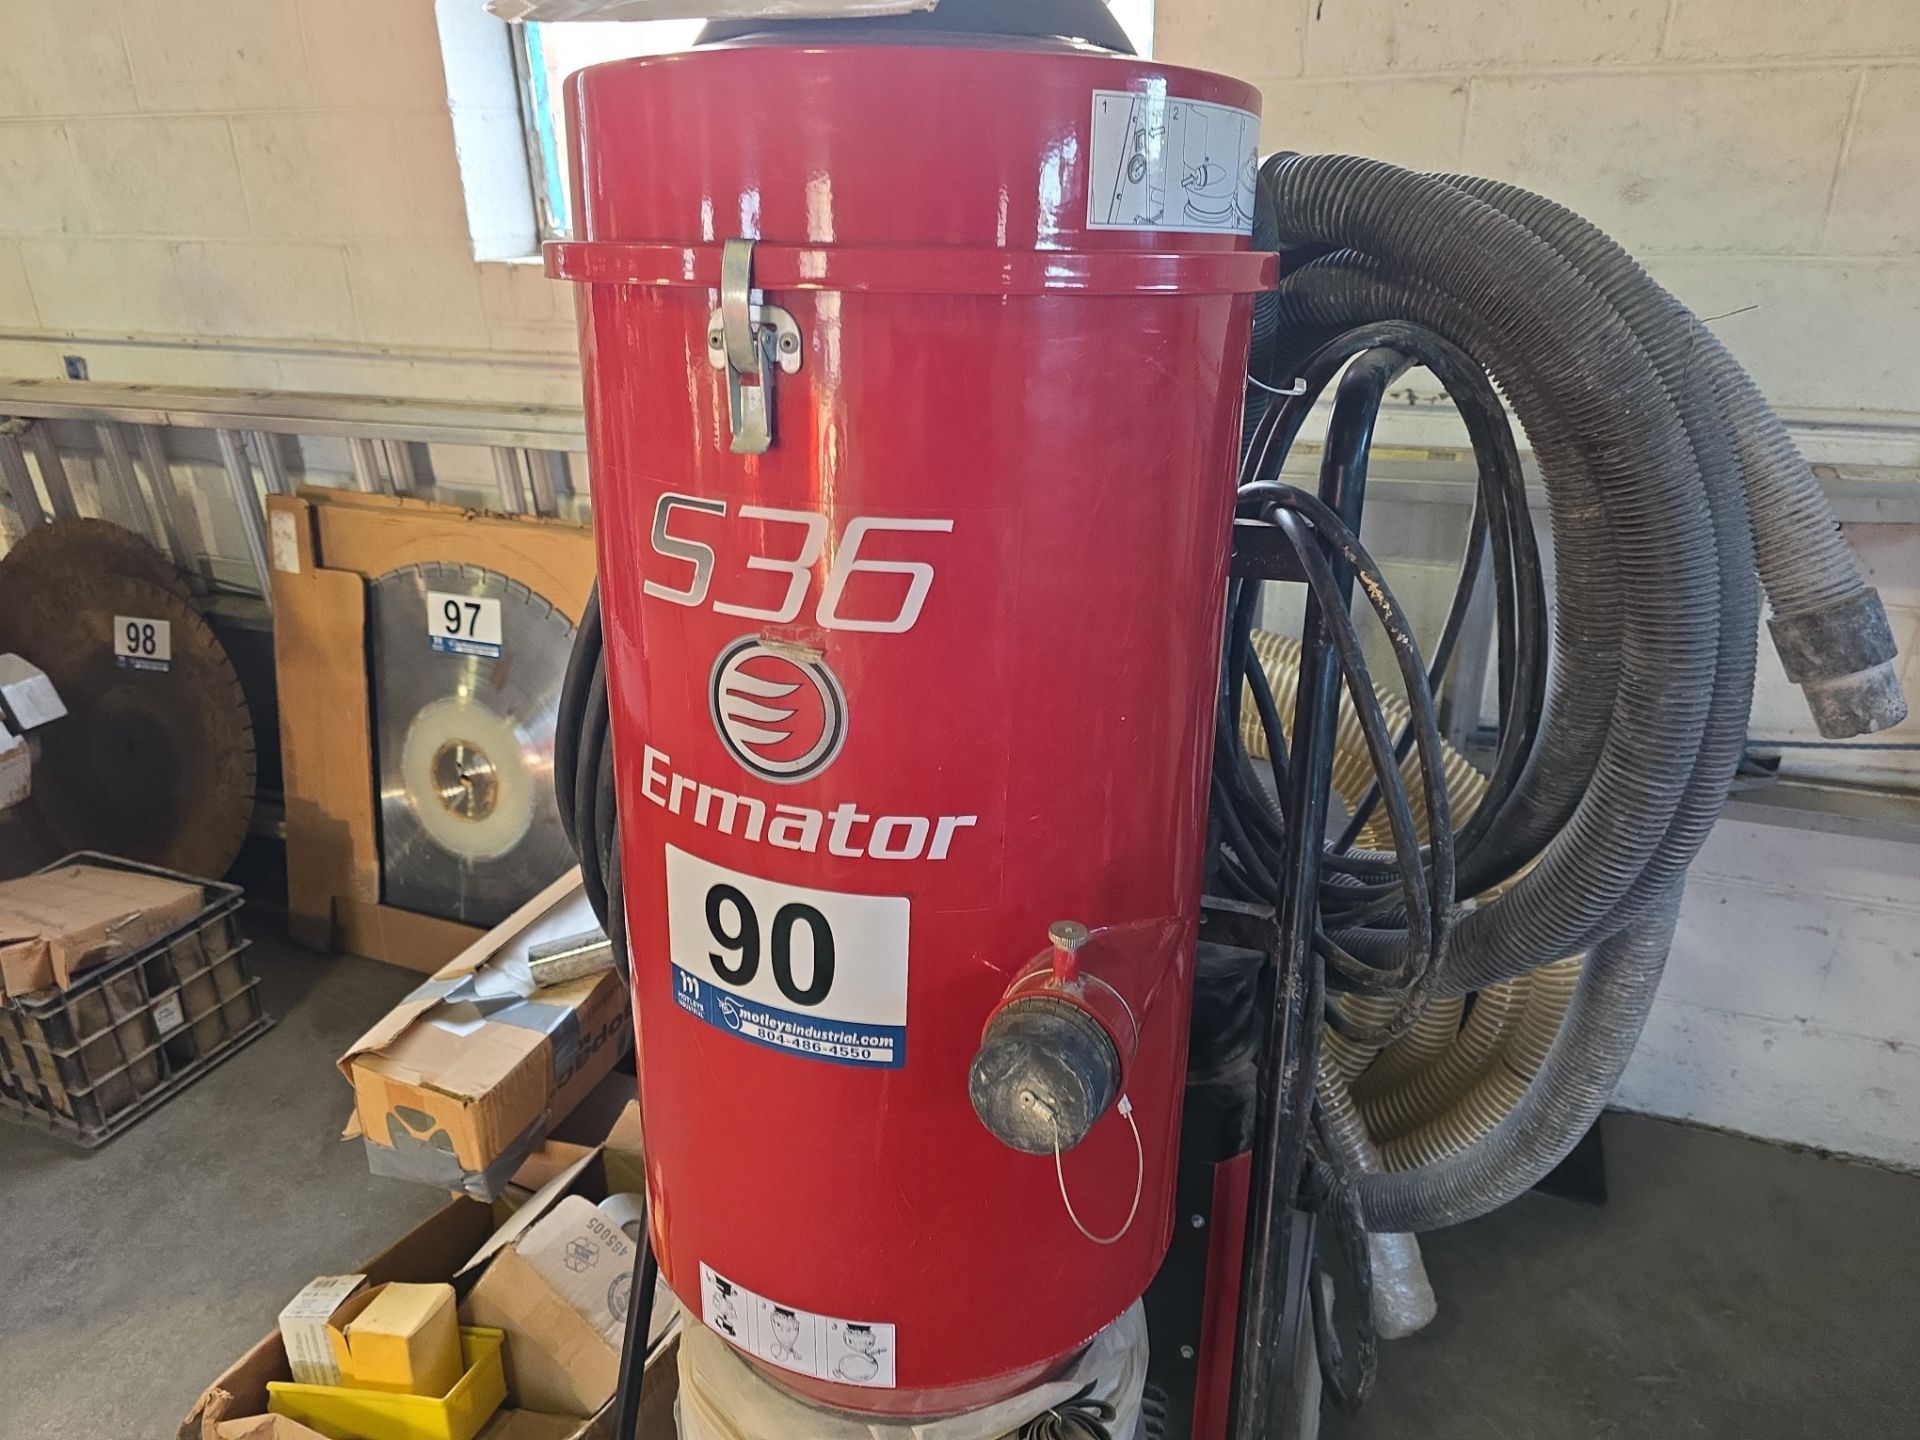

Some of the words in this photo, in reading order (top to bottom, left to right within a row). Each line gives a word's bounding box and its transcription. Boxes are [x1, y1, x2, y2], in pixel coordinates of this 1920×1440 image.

[1102, 100, 1107, 114] 1
[1173, 107, 1179, 121] 2
[643, 491, 954, 633] S36
[444, 600, 481, 636] 97
[126, 622, 156, 655] 98
[641, 744, 978, 860] Ermator
[705, 883, 835, 1006] 90
[739, 1007, 894, 1047] motleysindustrial.com
[757, 1028, 872, 1059] 804-486-4550
